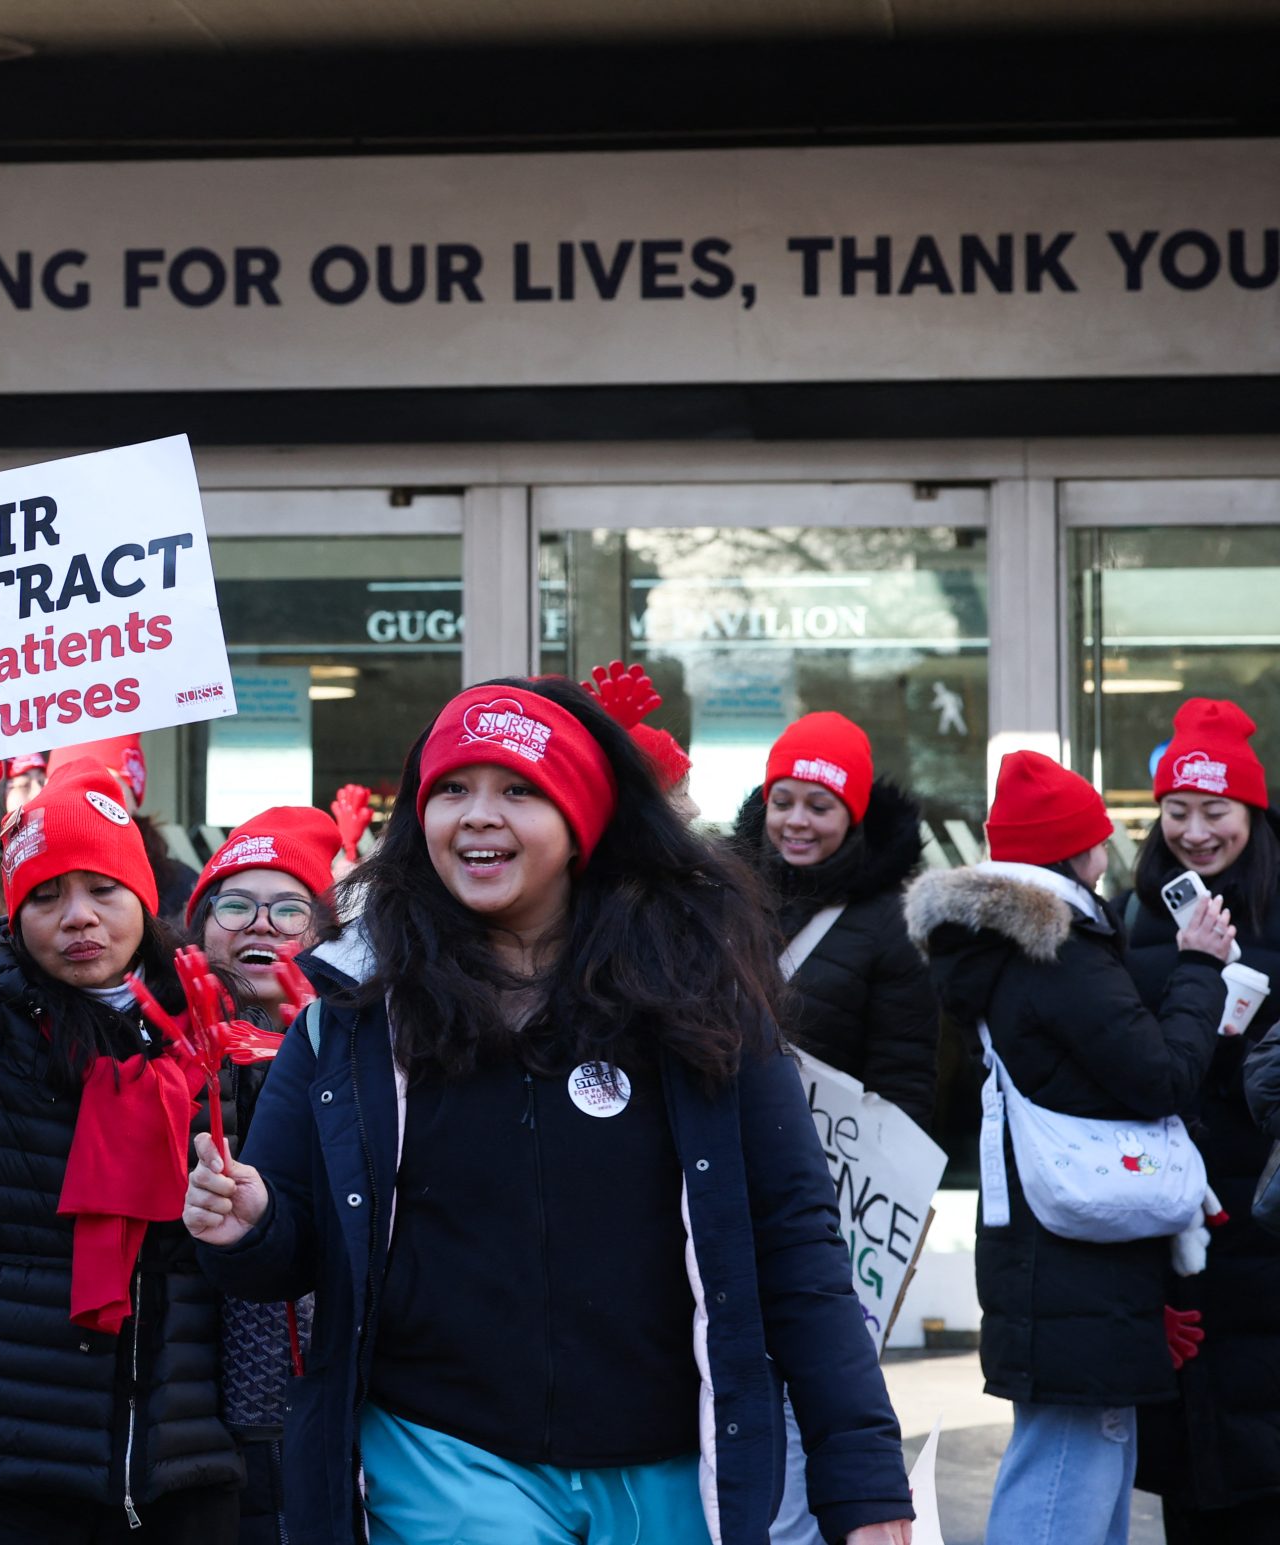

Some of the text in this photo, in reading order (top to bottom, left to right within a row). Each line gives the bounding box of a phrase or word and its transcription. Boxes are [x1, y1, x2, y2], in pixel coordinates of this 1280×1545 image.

[125, 246, 282, 309] FOR
[310, 242, 484, 306] OUR
[514, 236, 756, 310] LIVES,
[787, 231, 1078, 297] THANK
[1106, 228, 1280, 292] YOU
[175, 685, 224, 703] NURSES
[475, 726, 546, 752] ASSOCIATION
[479, 713, 552, 744] NURSES
